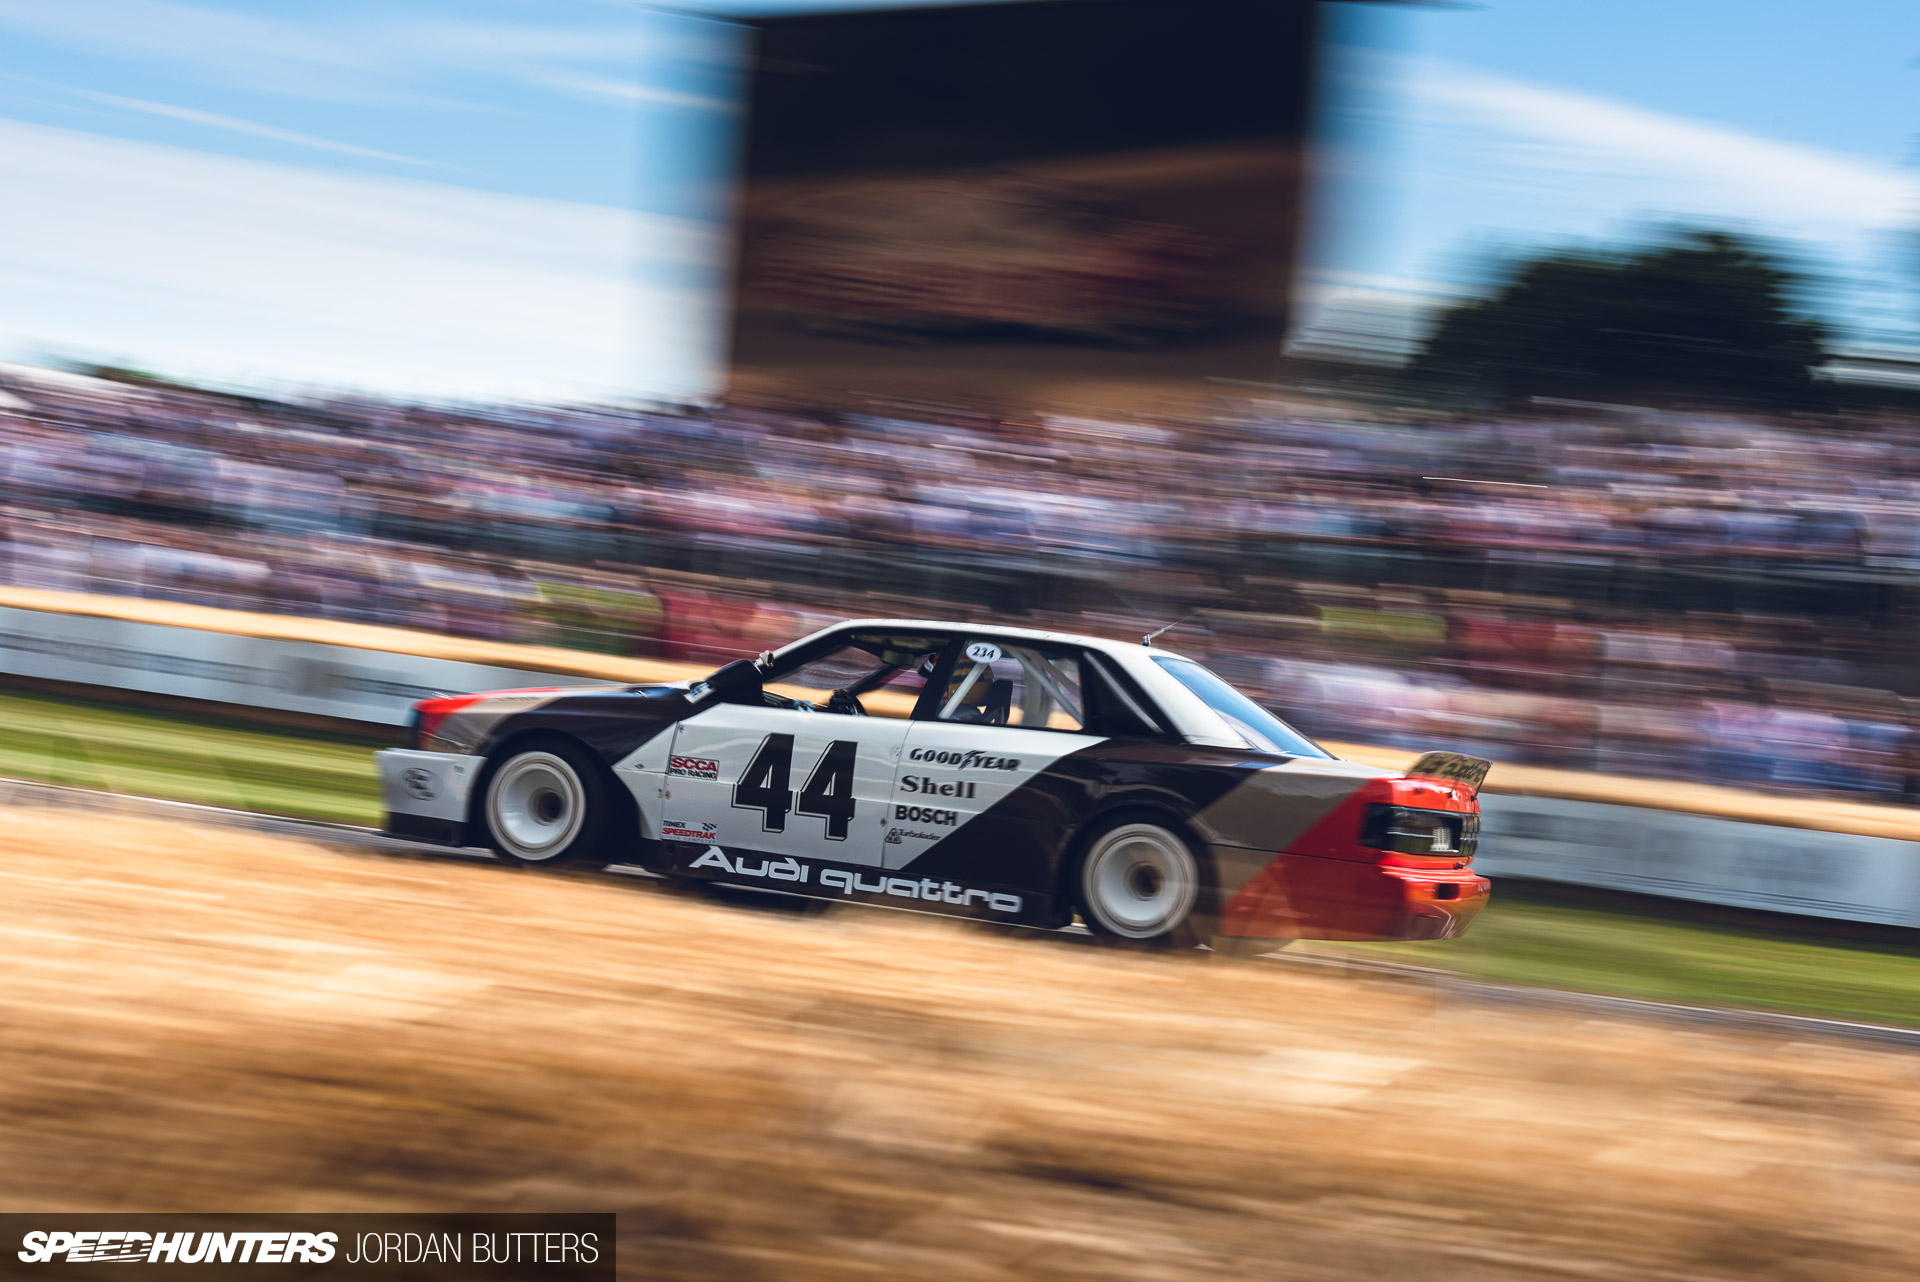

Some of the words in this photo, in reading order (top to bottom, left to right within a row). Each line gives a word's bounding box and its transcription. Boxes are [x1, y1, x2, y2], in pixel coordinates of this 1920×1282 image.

[972, 646, 995, 660] 234
[670, 757, 718, 772] SCCA
[909, 748, 1022, 771] GOODYEAR
[669, 767, 687, 776] PRO
[687, 769, 718, 780] RACING
[731, 732, 858, 842] 44
[900, 775, 977, 799] Shell
[662, 820, 687, 829] TIMEX
[894, 804, 959, 827] BOSCH
[661, 827, 717, 840] SPEEDTRAK
[688, 845, 810, 883] Audi
[819, 868, 1023, 913] quattro
